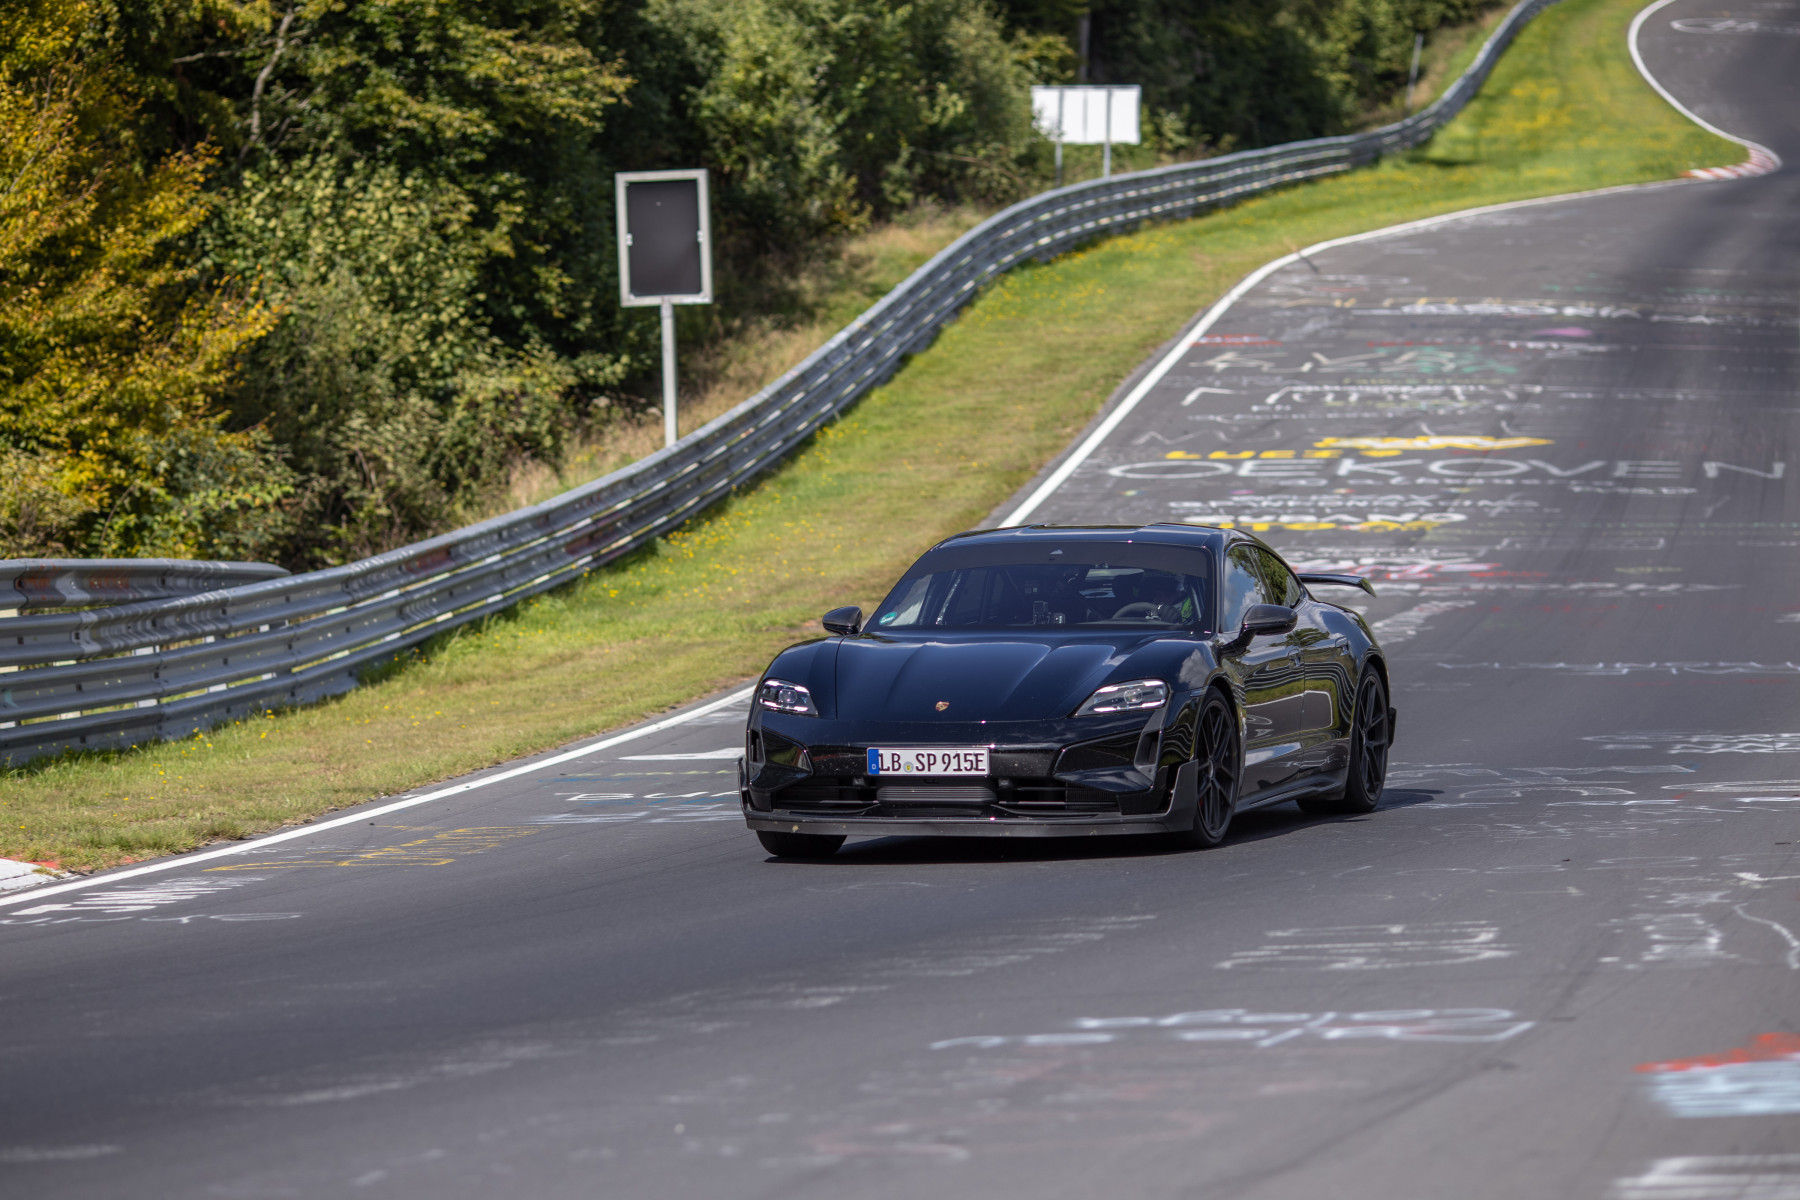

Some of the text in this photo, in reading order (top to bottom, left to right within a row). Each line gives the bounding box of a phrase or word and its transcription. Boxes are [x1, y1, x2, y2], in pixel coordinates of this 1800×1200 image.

[879, 753, 986, 772] LB SP 915E
